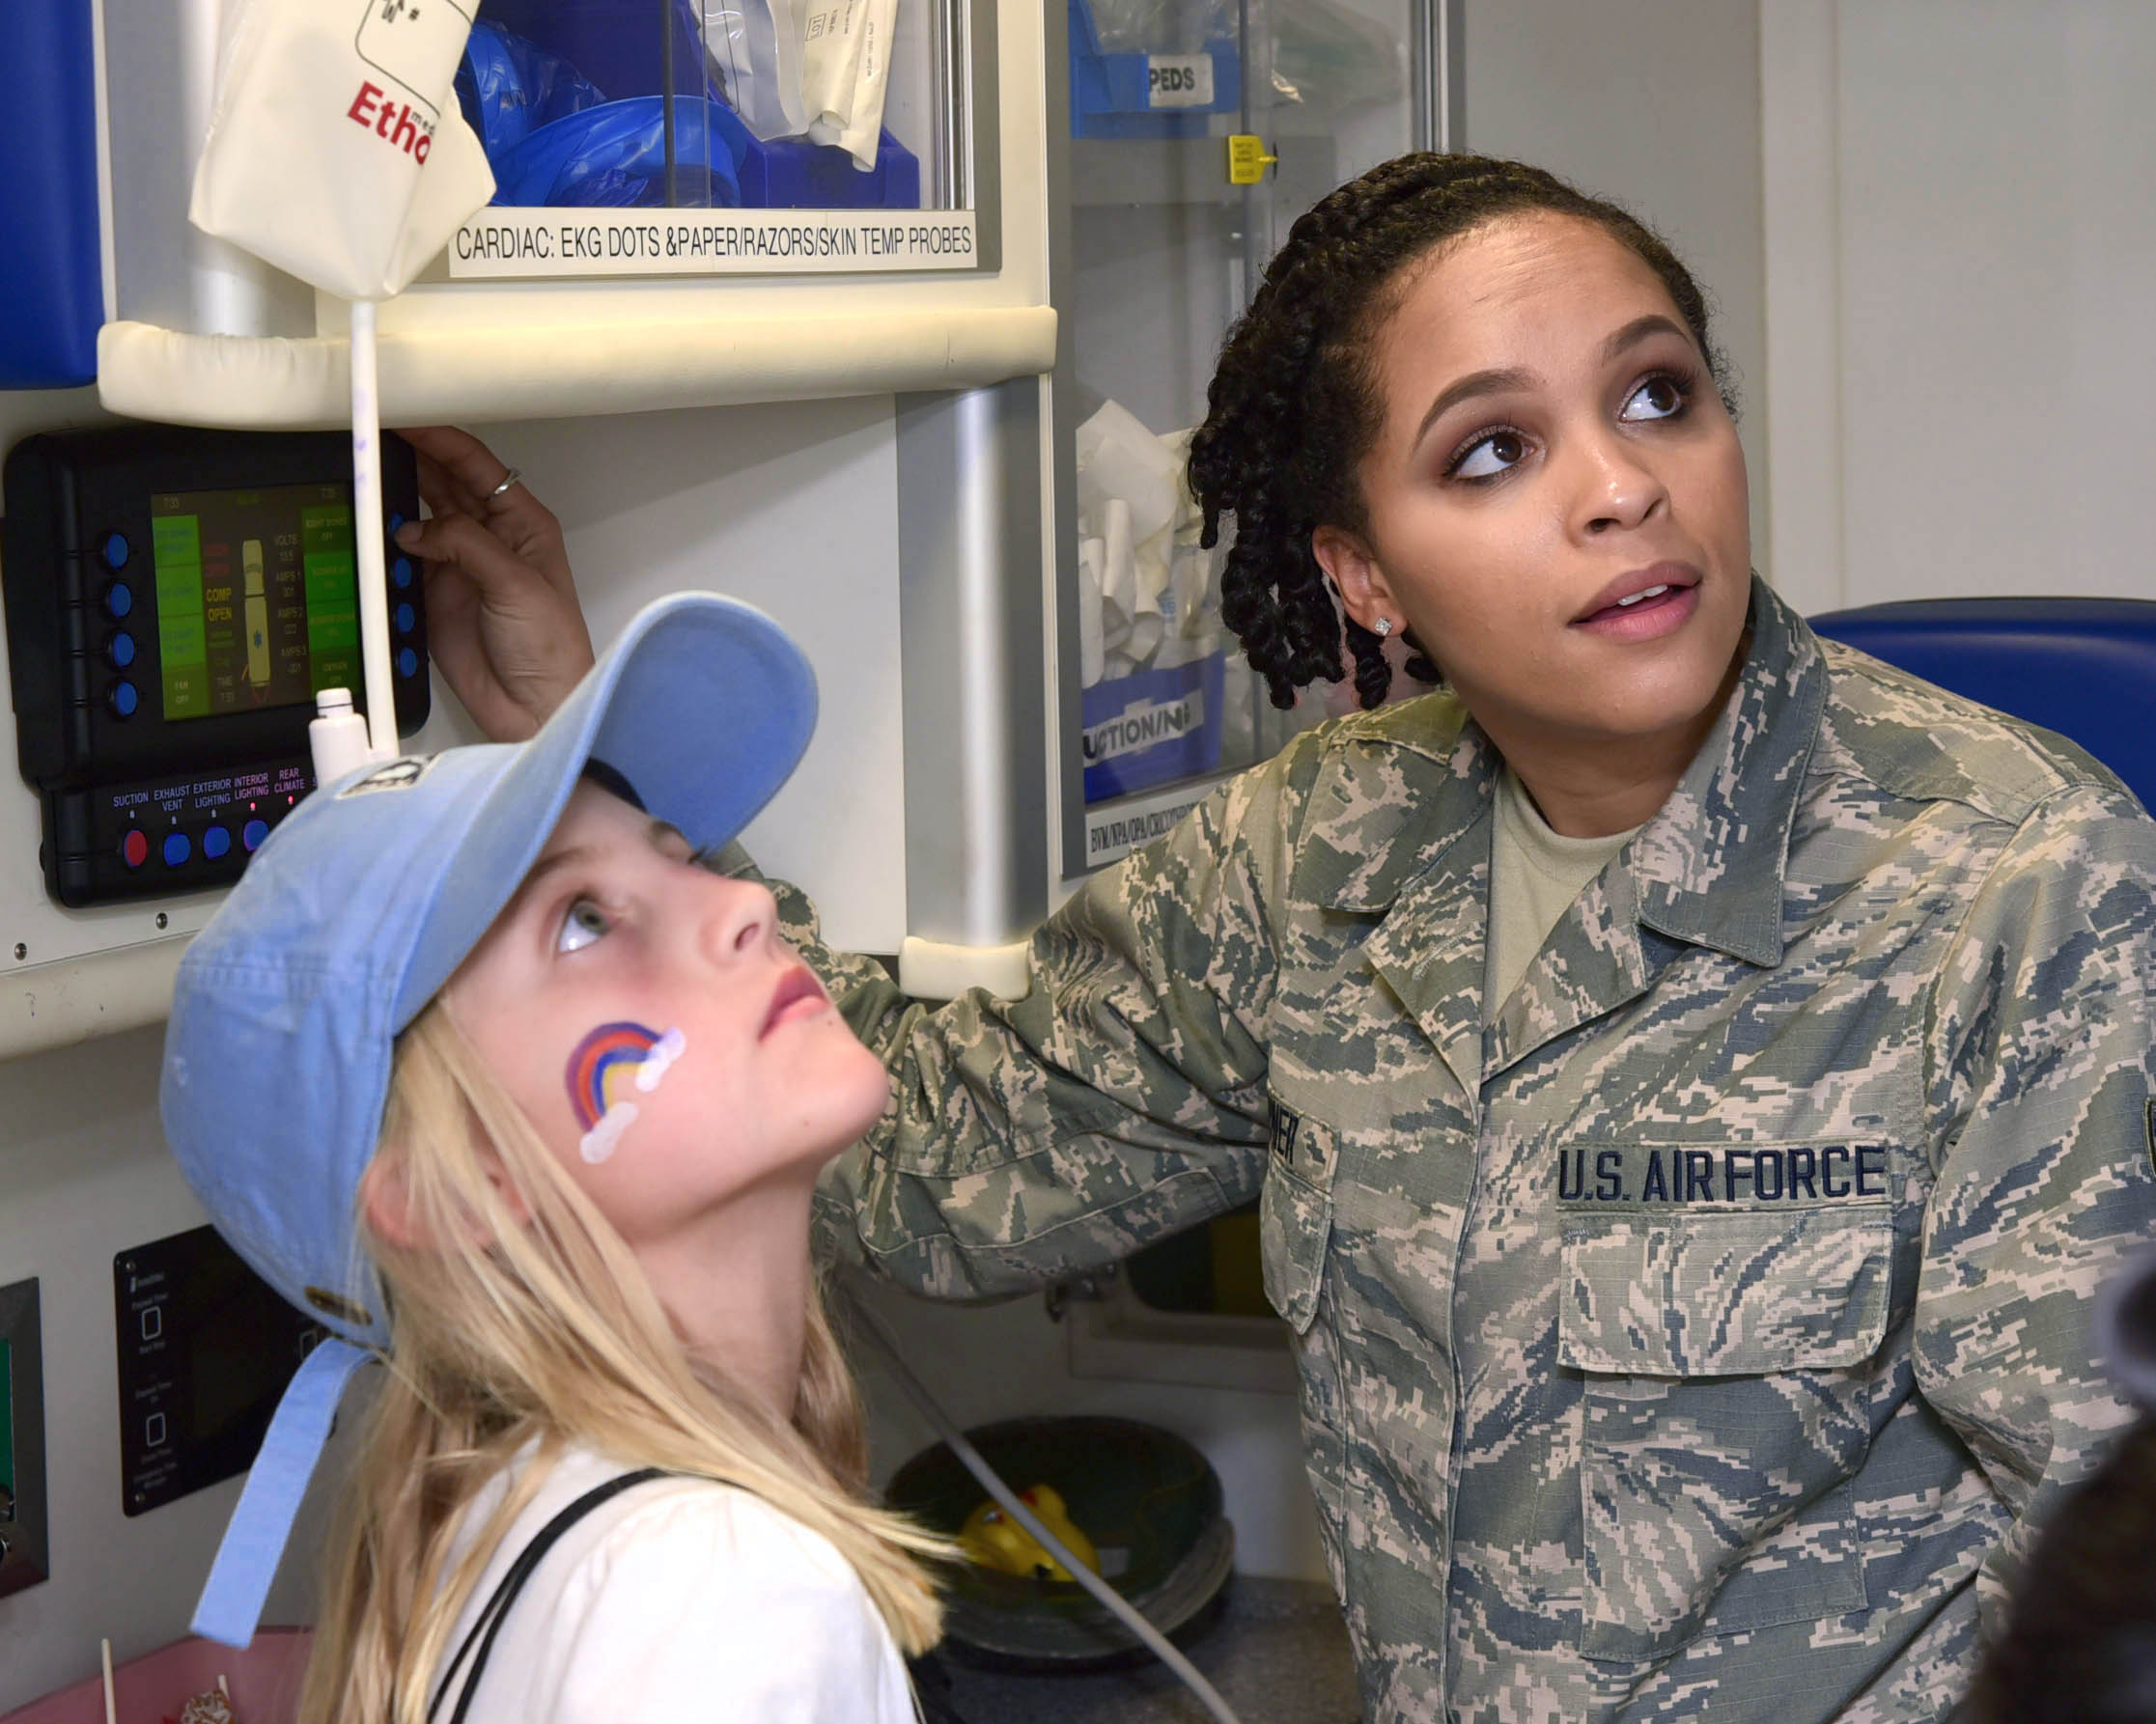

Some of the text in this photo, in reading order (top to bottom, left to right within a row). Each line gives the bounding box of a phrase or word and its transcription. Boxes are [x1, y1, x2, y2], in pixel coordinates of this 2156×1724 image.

[1148, 67, 1195, 92] PEDS
[457, 225, 972, 260] CARDIAC: EKG DOTS &PAPER/RAZORS/SKIN TEMP PROBES
[207, 588, 233, 602] COMP
[209, 607, 233, 622] OPEN
[234, 773, 269, 788] INTERIOR
[279, 767, 299, 781] REAR
[154, 785, 191, 799] EXHAUST
[193, 779, 232, 794] EXTERIOR
[235, 785, 269, 800] LIGHTING
[273, 779, 306, 793] CLIMATE
[113, 792, 149, 807] SUCTION
[162, 798, 182, 812] VENT
[194, 793, 231, 809] LIGHTING
[1558, 1145, 1887, 1202] U.S. AIR FORCE
